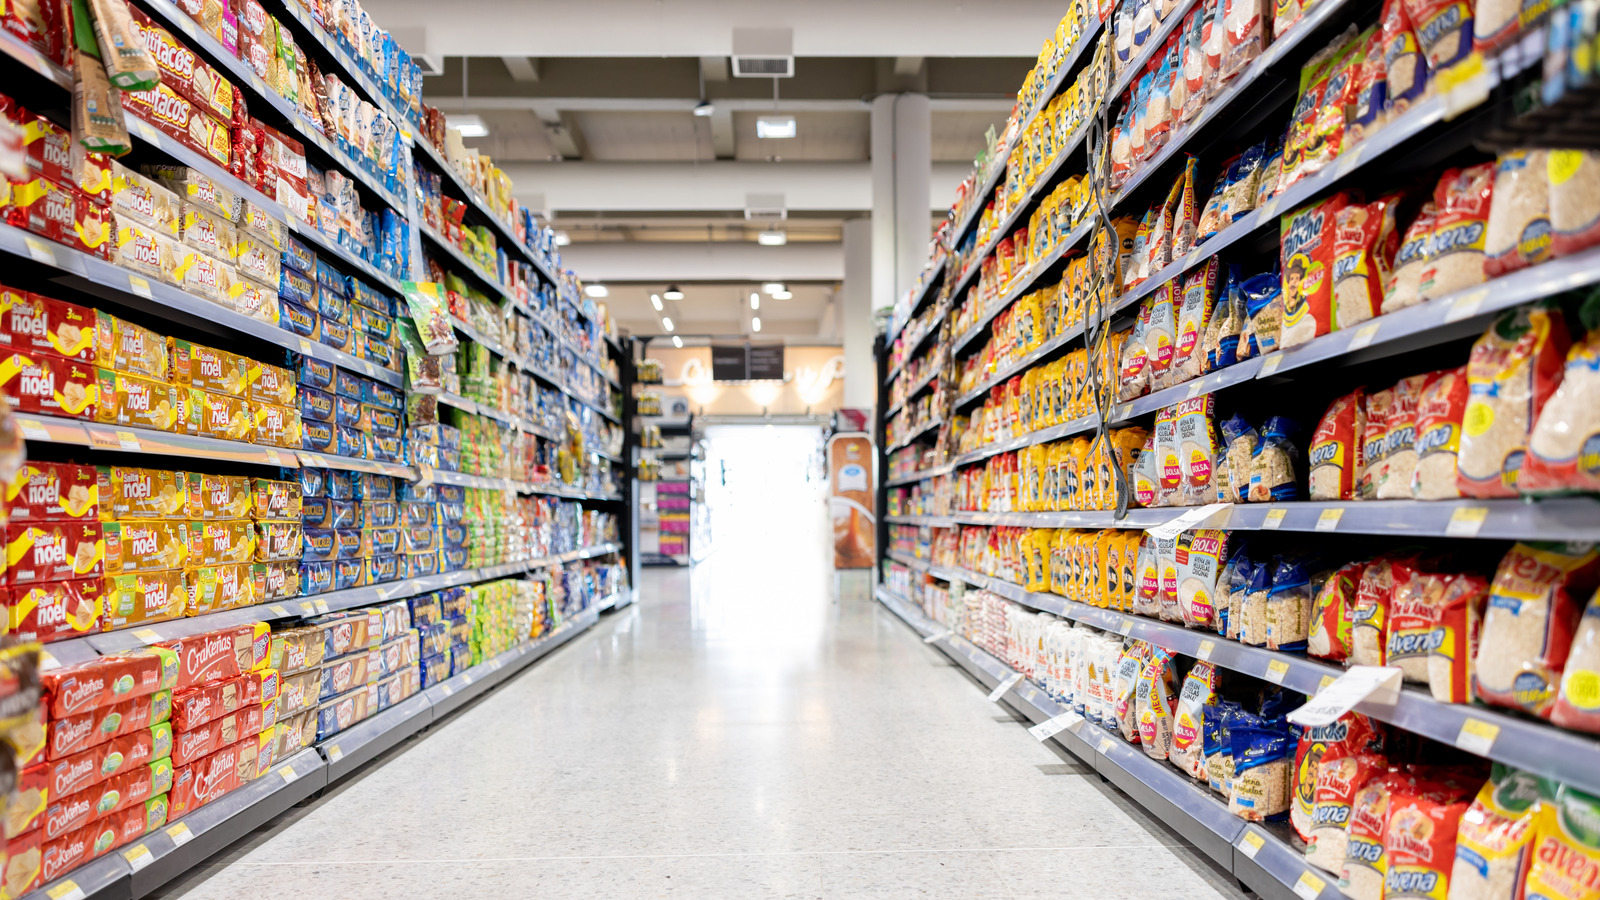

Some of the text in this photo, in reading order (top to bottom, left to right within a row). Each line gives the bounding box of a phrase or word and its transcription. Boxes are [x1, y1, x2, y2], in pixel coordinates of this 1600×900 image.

[46, 198, 75, 225] noel
[130, 194, 154, 217] noel
[135, 245, 160, 266] noel
[198, 268, 216, 286] noel
[11, 312, 48, 337] noel
[291, 310, 312, 326] DUCALES
[122, 332, 144, 354] noel
[201, 359, 222, 378] noel
[20, 372, 54, 396] noel
[127, 390, 150, 411] noel
[1191, 465, 1209, 473] BOLSA
[29, 478, 60, 504] noel
[124, 477, 151, 498] noel
[34, 537, 67, 565] noel
[132, 531, 158, 555] noel
[144, 583, 168, 609] noel
[37, 595, 68, 626] noel
[1191, 604, 1210, 614] BOLSA
[187, 635, 232, 675] Crakeñas
[64, 678, 104, 709] Crakeñas
[56, 760, 94, 794] Crakeñas
[47, 800, 90, 836] Crakeñas
[44, 841, 84, 880] Crakeñas
